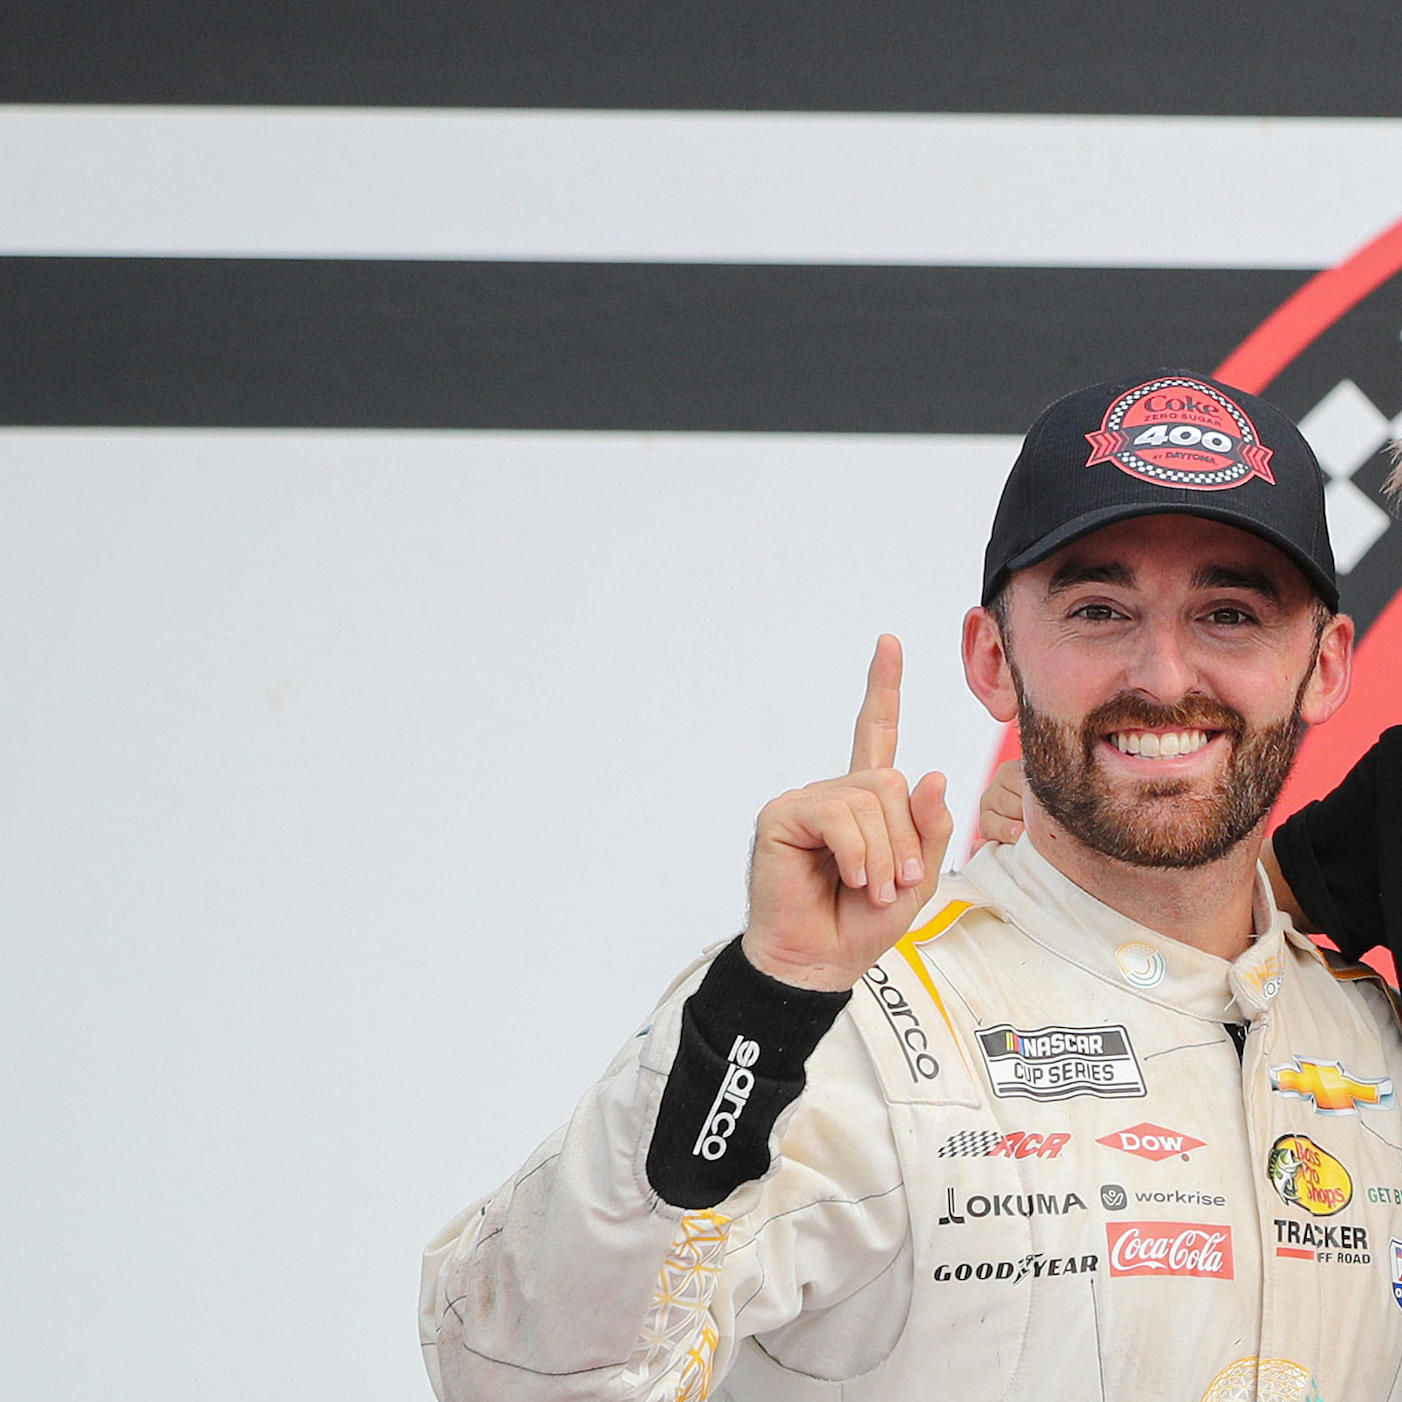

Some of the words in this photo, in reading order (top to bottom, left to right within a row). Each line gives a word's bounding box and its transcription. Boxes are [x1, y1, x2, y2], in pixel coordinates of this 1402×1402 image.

[1144, 394, 1221, 419] Coke
[1144, 413, 1178, 422] ZERO
[1180, 413, 1222, 427] SUGAR
[1133, 425, 1232, 452] 400
[864, 965, 940, 1083] parco
[1023, 1033, 1104, 1055] NASCAR
[1014, 1062, 1044, 1084] CUP
[1048, 1062, 1115, 1083] SERIES
[1135, 1190, 1226, 1206] workrise
[1367, 1187, 1392, 1203] GET
[1111, 1228, 1228, 1273] Coca-Cola
[1337, 1252, 1371, 1264] ROAD
